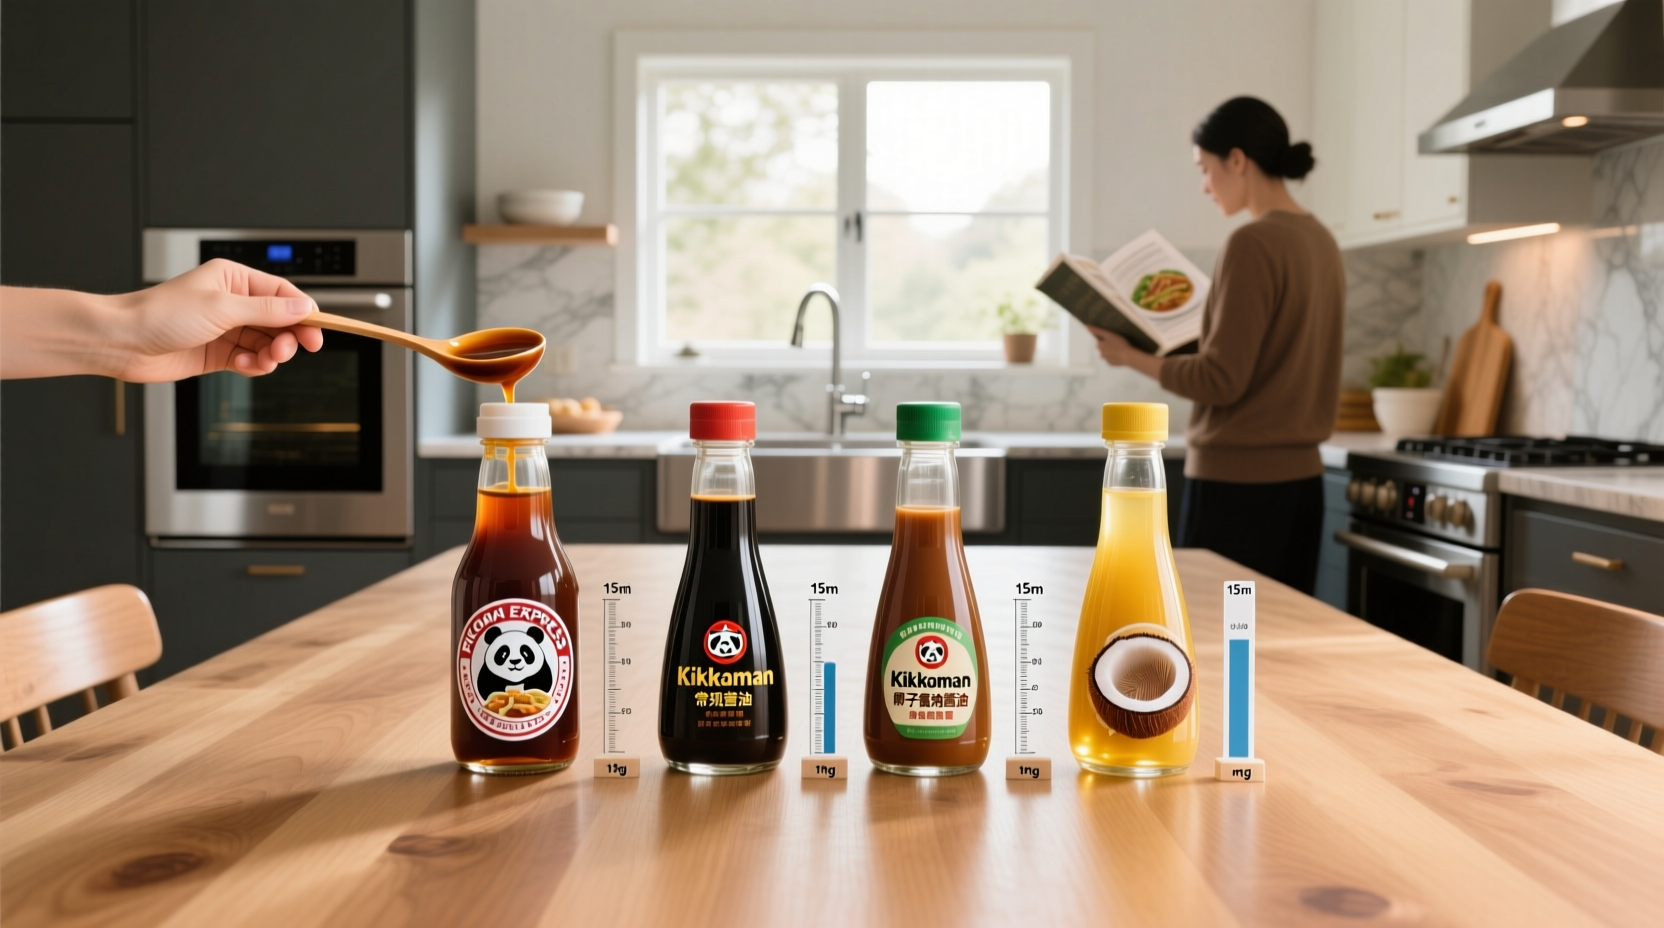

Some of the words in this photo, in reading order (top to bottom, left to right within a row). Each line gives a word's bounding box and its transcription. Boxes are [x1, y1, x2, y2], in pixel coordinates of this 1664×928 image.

[603, 582, 632, 594] 15m
[810, 582, 839, 595] 15m
[1015, 582, 1044, 595] 15m
[1227, 583, 1252, 595] 15m
[890, 670, 971, 688] Kikkoman
[1232, 768, 1252, 781] mg
